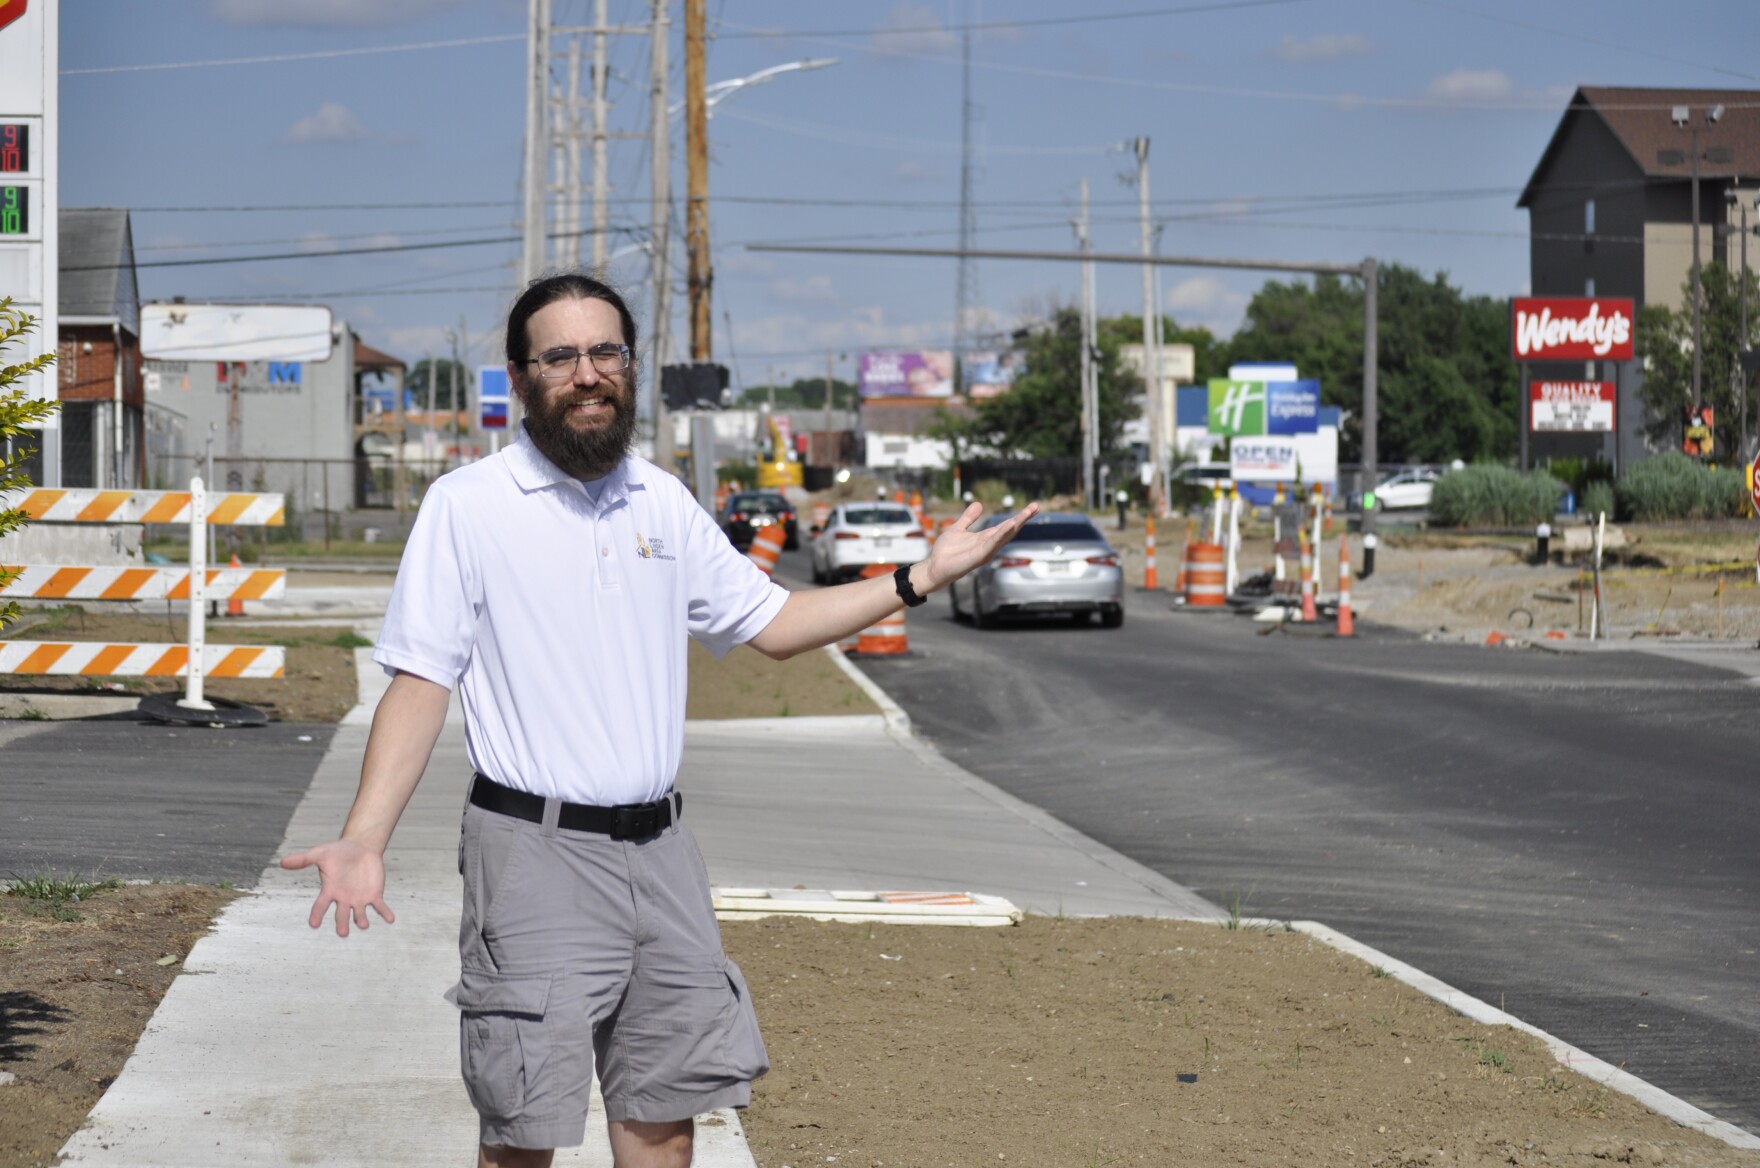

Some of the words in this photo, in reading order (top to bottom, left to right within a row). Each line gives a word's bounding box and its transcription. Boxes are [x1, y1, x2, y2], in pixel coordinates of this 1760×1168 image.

[4, 124, 17, 148] 9
[2, 149, 20, 173] 10
[4, 186, 17, 210] 9
[2, 210, 20, 234] 10
[1516, 302, 1631, 356] Wendy's
[1541, 382, 1602, 396] QUALITY
[1234, 445, 1293, 457] OPEN
